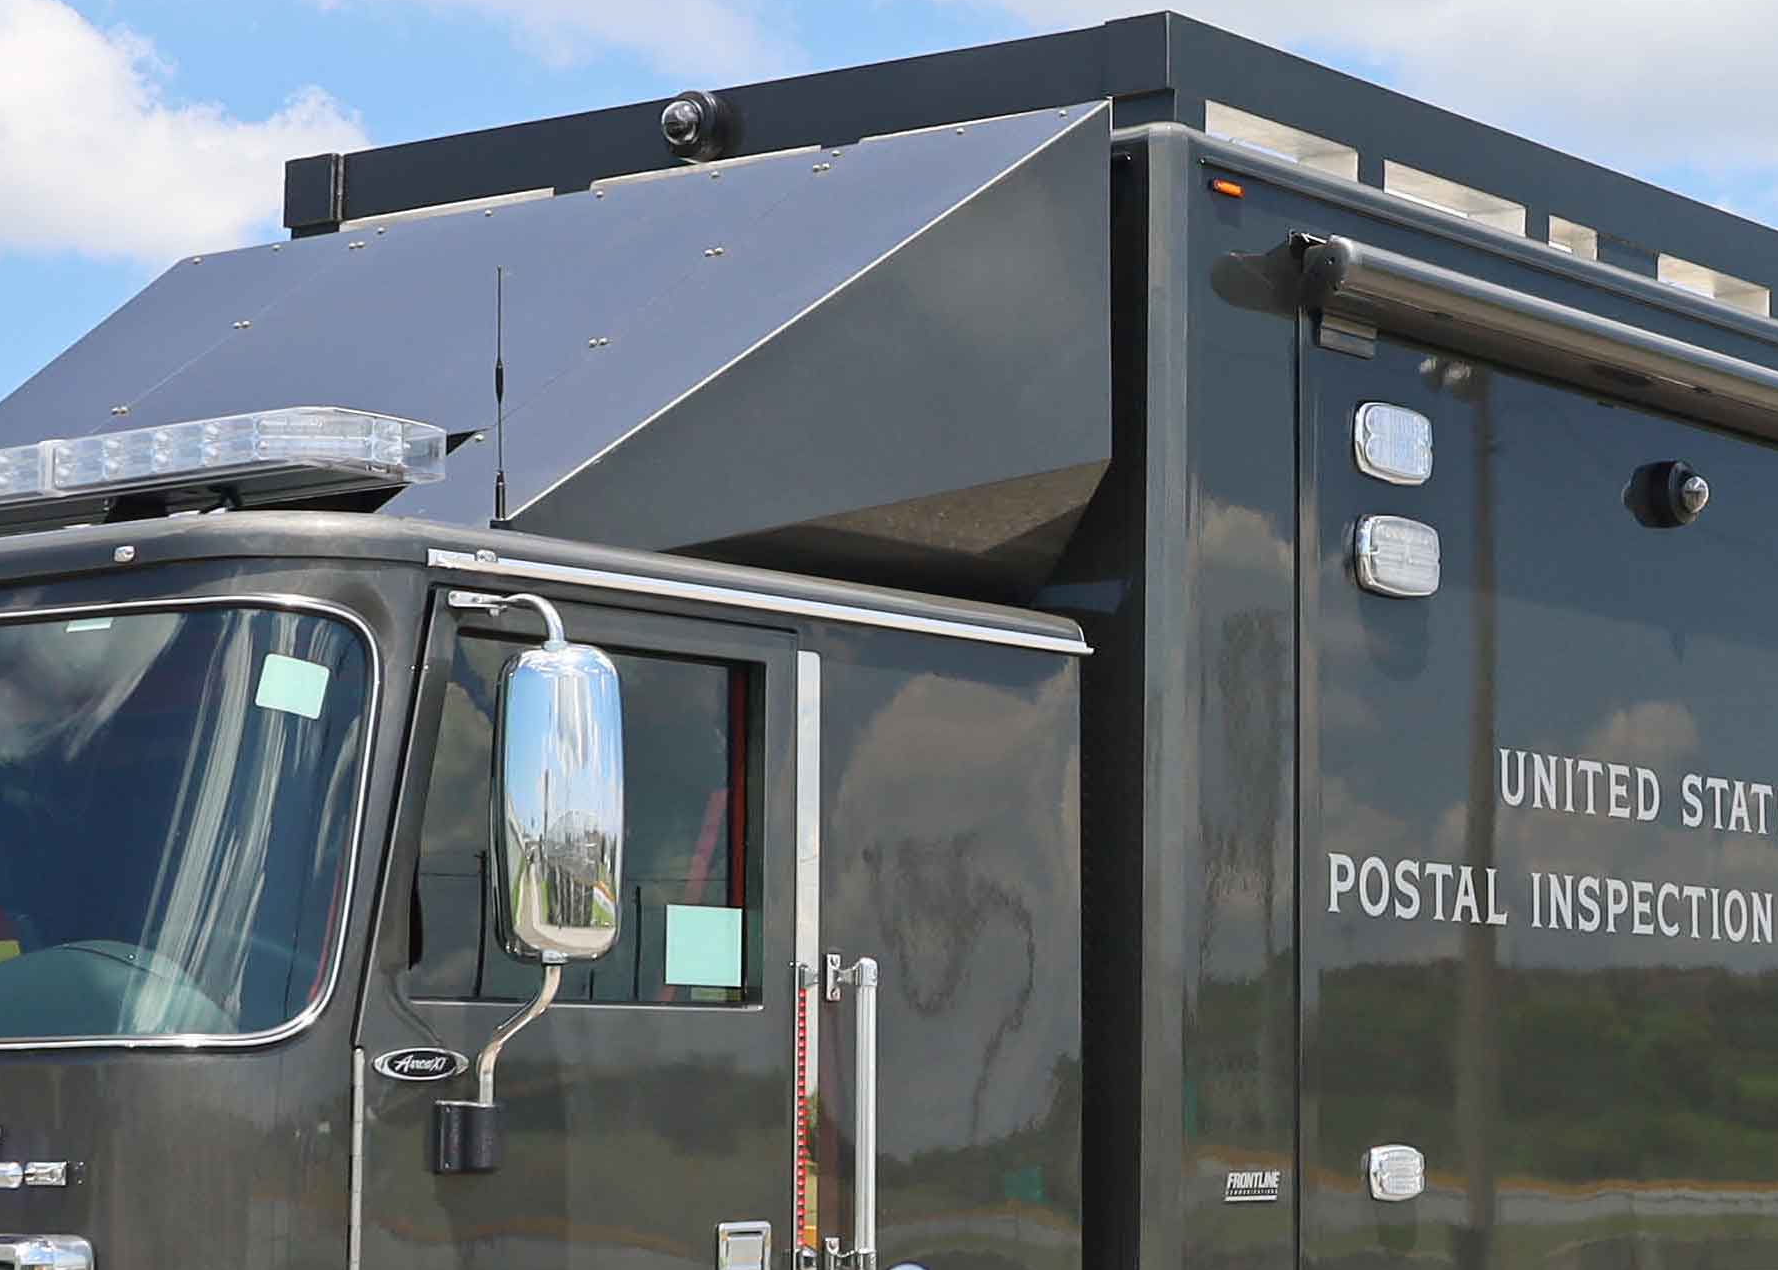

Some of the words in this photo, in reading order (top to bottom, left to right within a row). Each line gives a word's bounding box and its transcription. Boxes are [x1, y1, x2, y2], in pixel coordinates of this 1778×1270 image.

[1499, 747, 1661, 821] UNITED
[1327, 852, 1509, 926] POSTAL
[1531, 872, 1773, 944] INSPECTION
[1226, 1171, 1281, 1189] FRONTLINE
